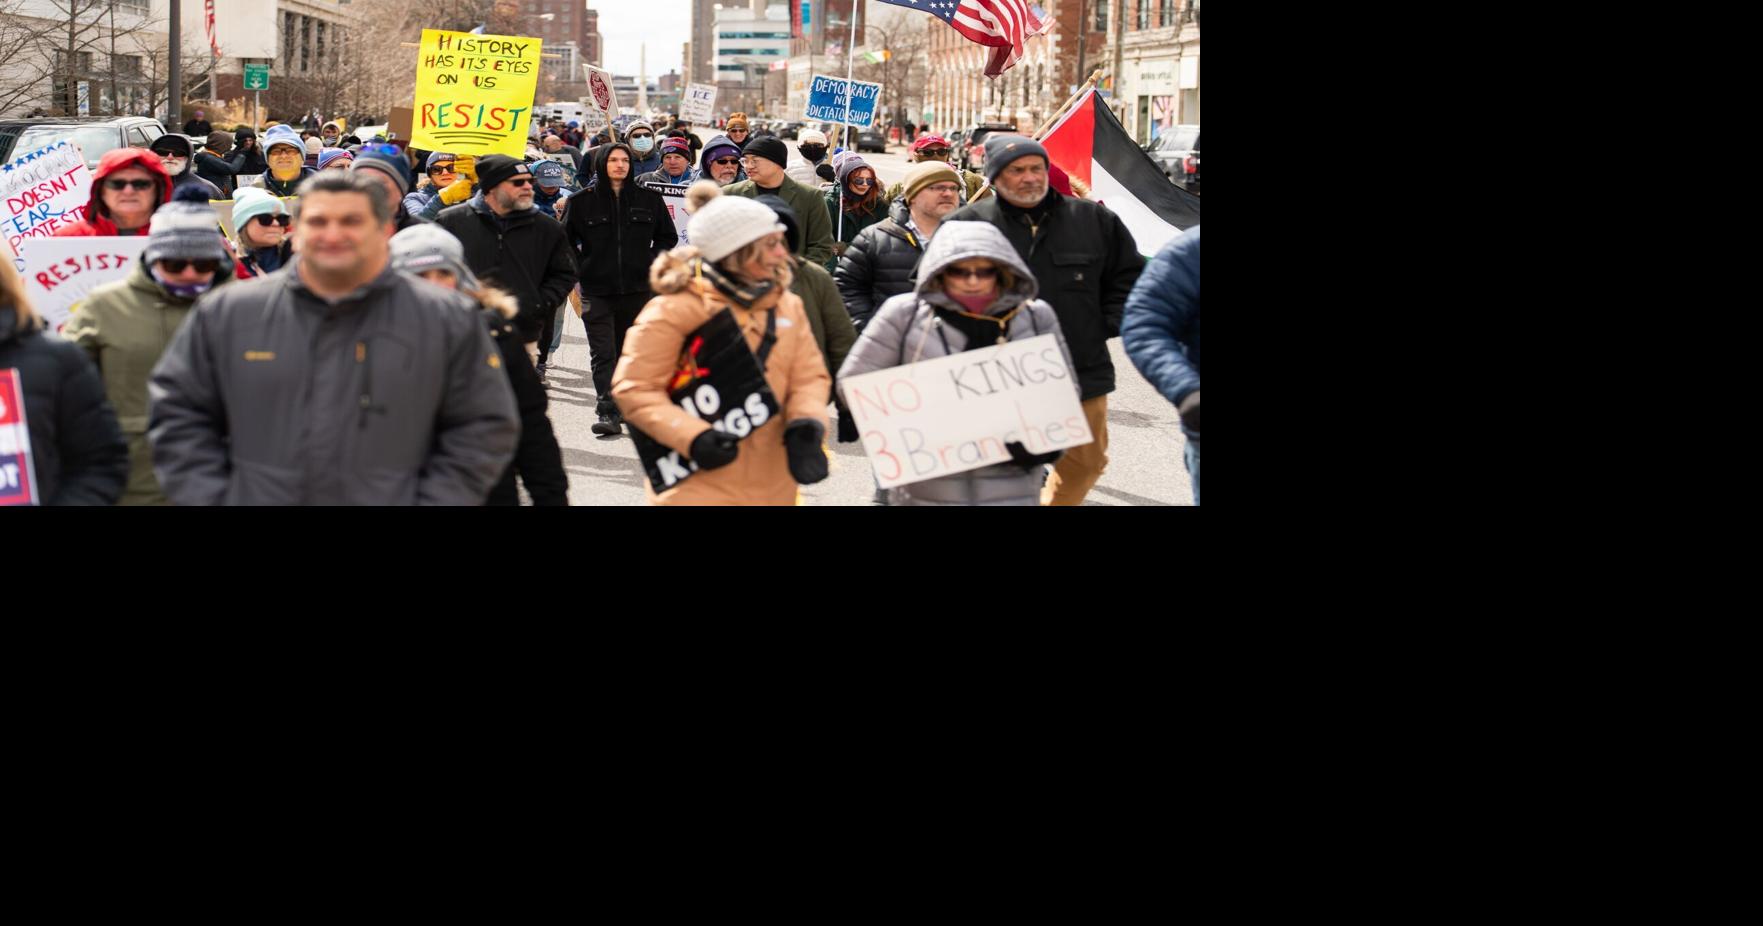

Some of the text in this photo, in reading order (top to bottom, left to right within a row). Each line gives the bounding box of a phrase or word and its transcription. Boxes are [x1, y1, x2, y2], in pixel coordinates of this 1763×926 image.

[438, 34, 528, 58] HISTORY
[425, 54, 532, 74] HAS IT'S EYES
[436, 74, 497, 88] ON US
[421, 101, 528, 131] RESIST
[809, 104, 870, 123] DICTATOSHIP
[0, 202, 66, 240] FEAR
[35, 253, 129, 291] RESIST
[852, 347, 1068, 422] NO KINGS
[865, 430, 902, 481] 3
